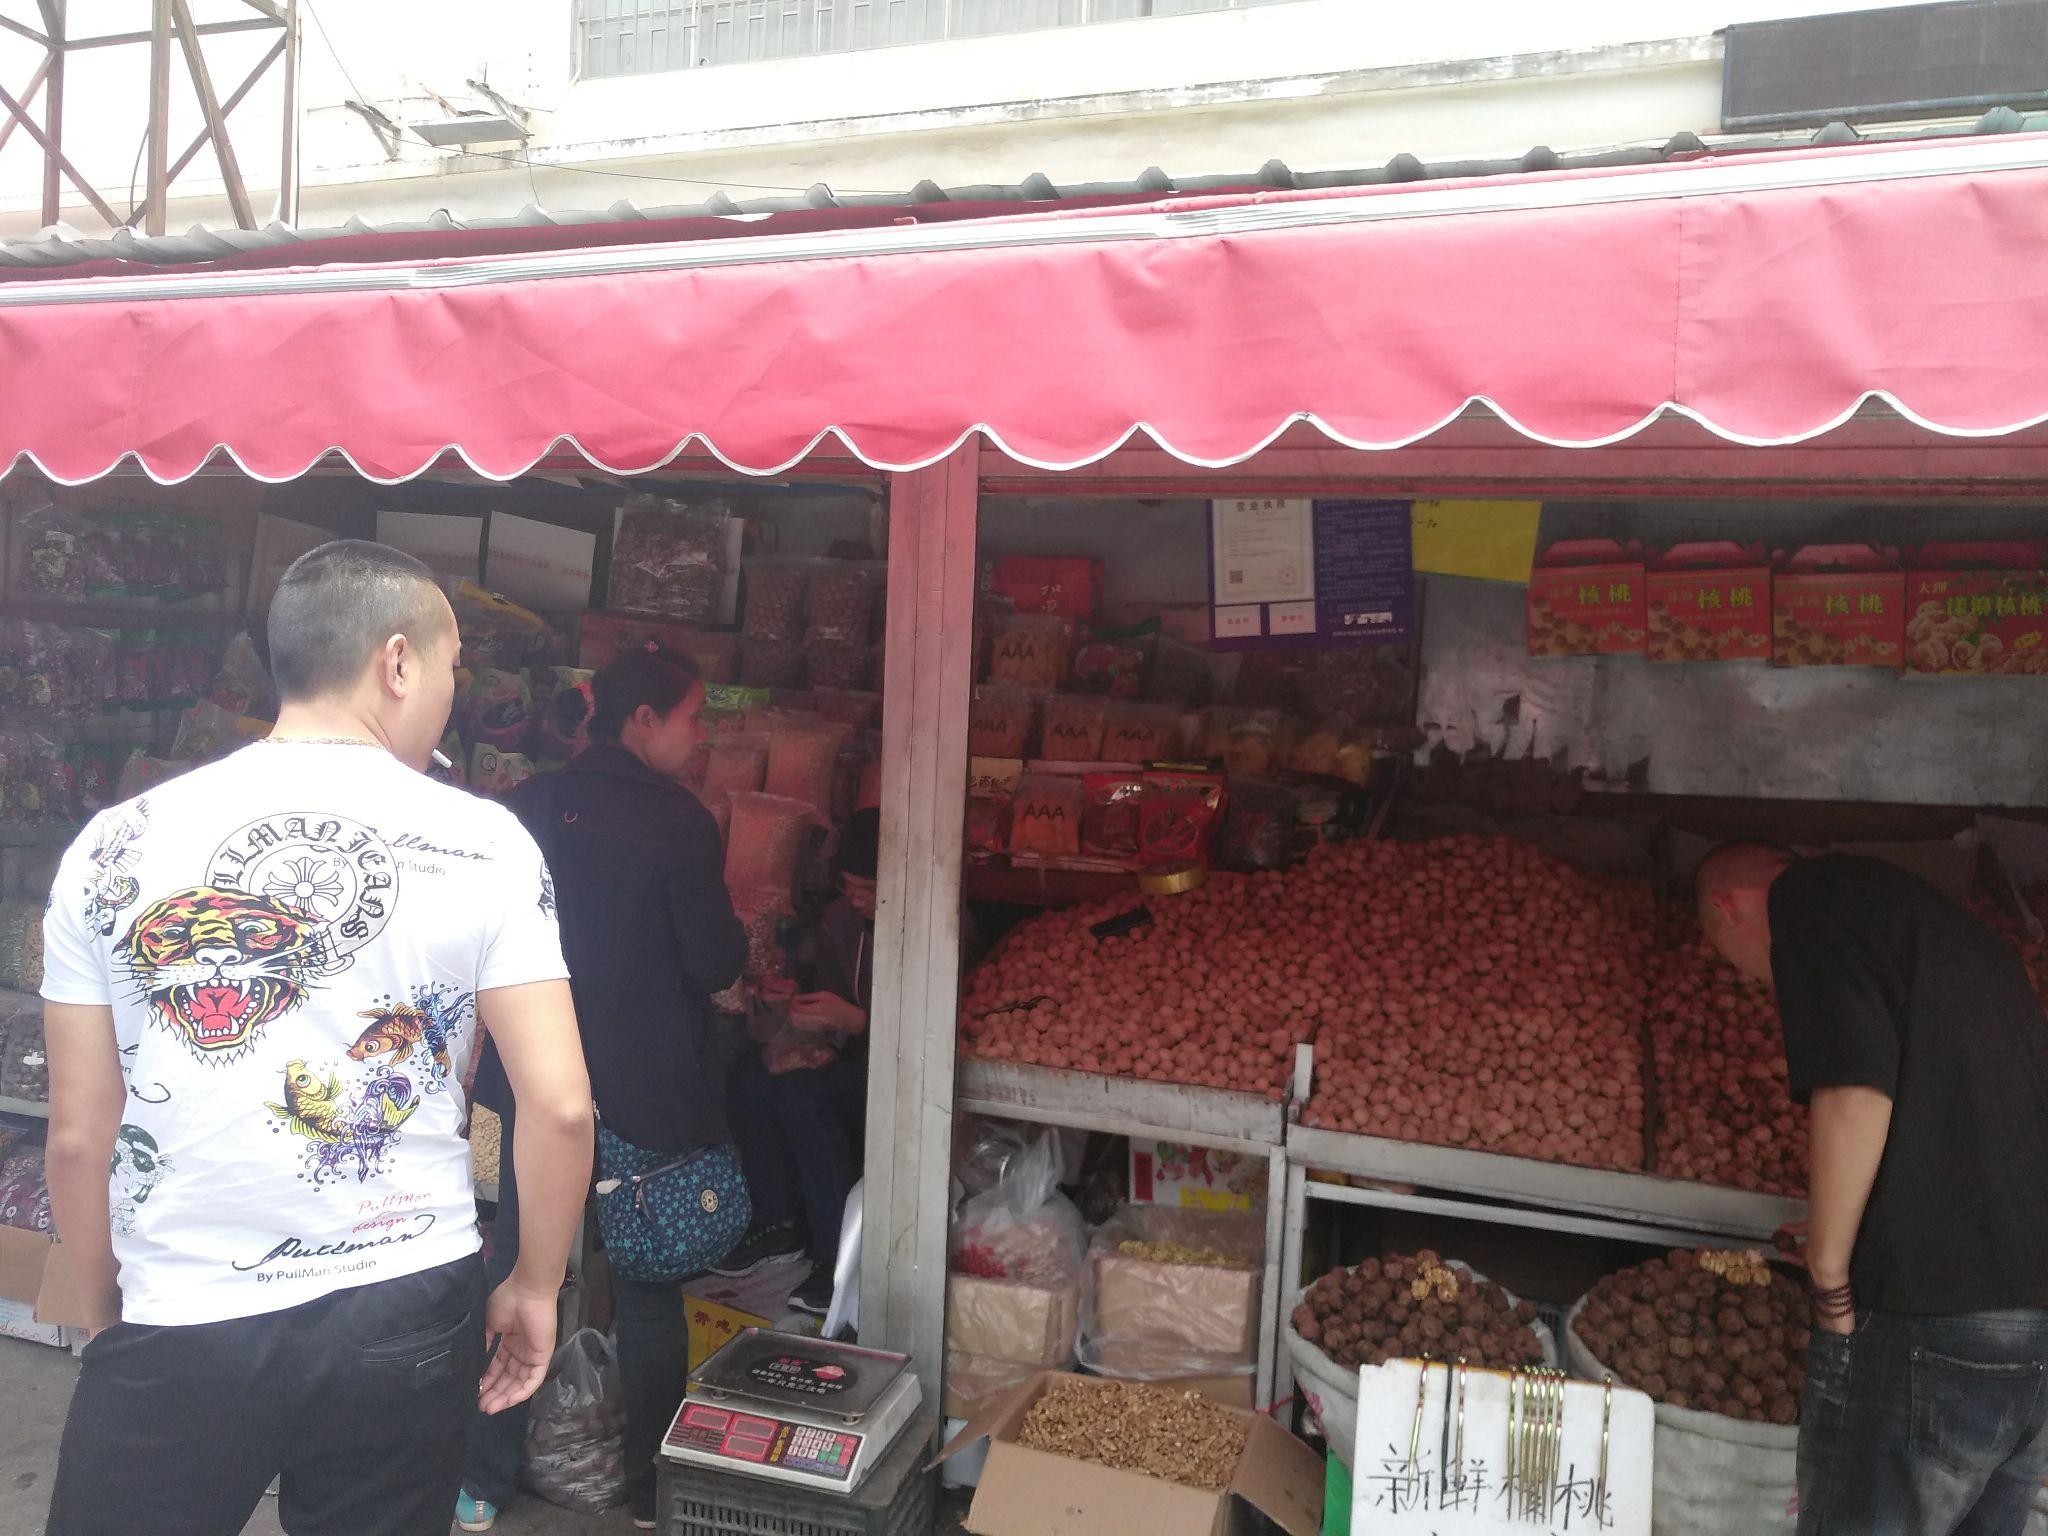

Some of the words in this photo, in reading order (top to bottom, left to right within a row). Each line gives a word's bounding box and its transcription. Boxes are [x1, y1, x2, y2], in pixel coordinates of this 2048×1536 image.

[1577, 583, 1632, 606] 核桃
[1697, 586, 1754, 609] 核桃
[1824, 593, 1885, 615] 核桃
[1000, 642, 1035, 660] AAA
[1052, 723, 1089, 739] AAA
[1023, 803, 1066, 820] AAA
[408, 859, 446, 875] Studio
[352, 1215, 408, 1234] design
[257, 1272, 273, 1284] By
[276, 1267, 331, 1280] PullMan
[335, 1259, 377, 1275] Studio
